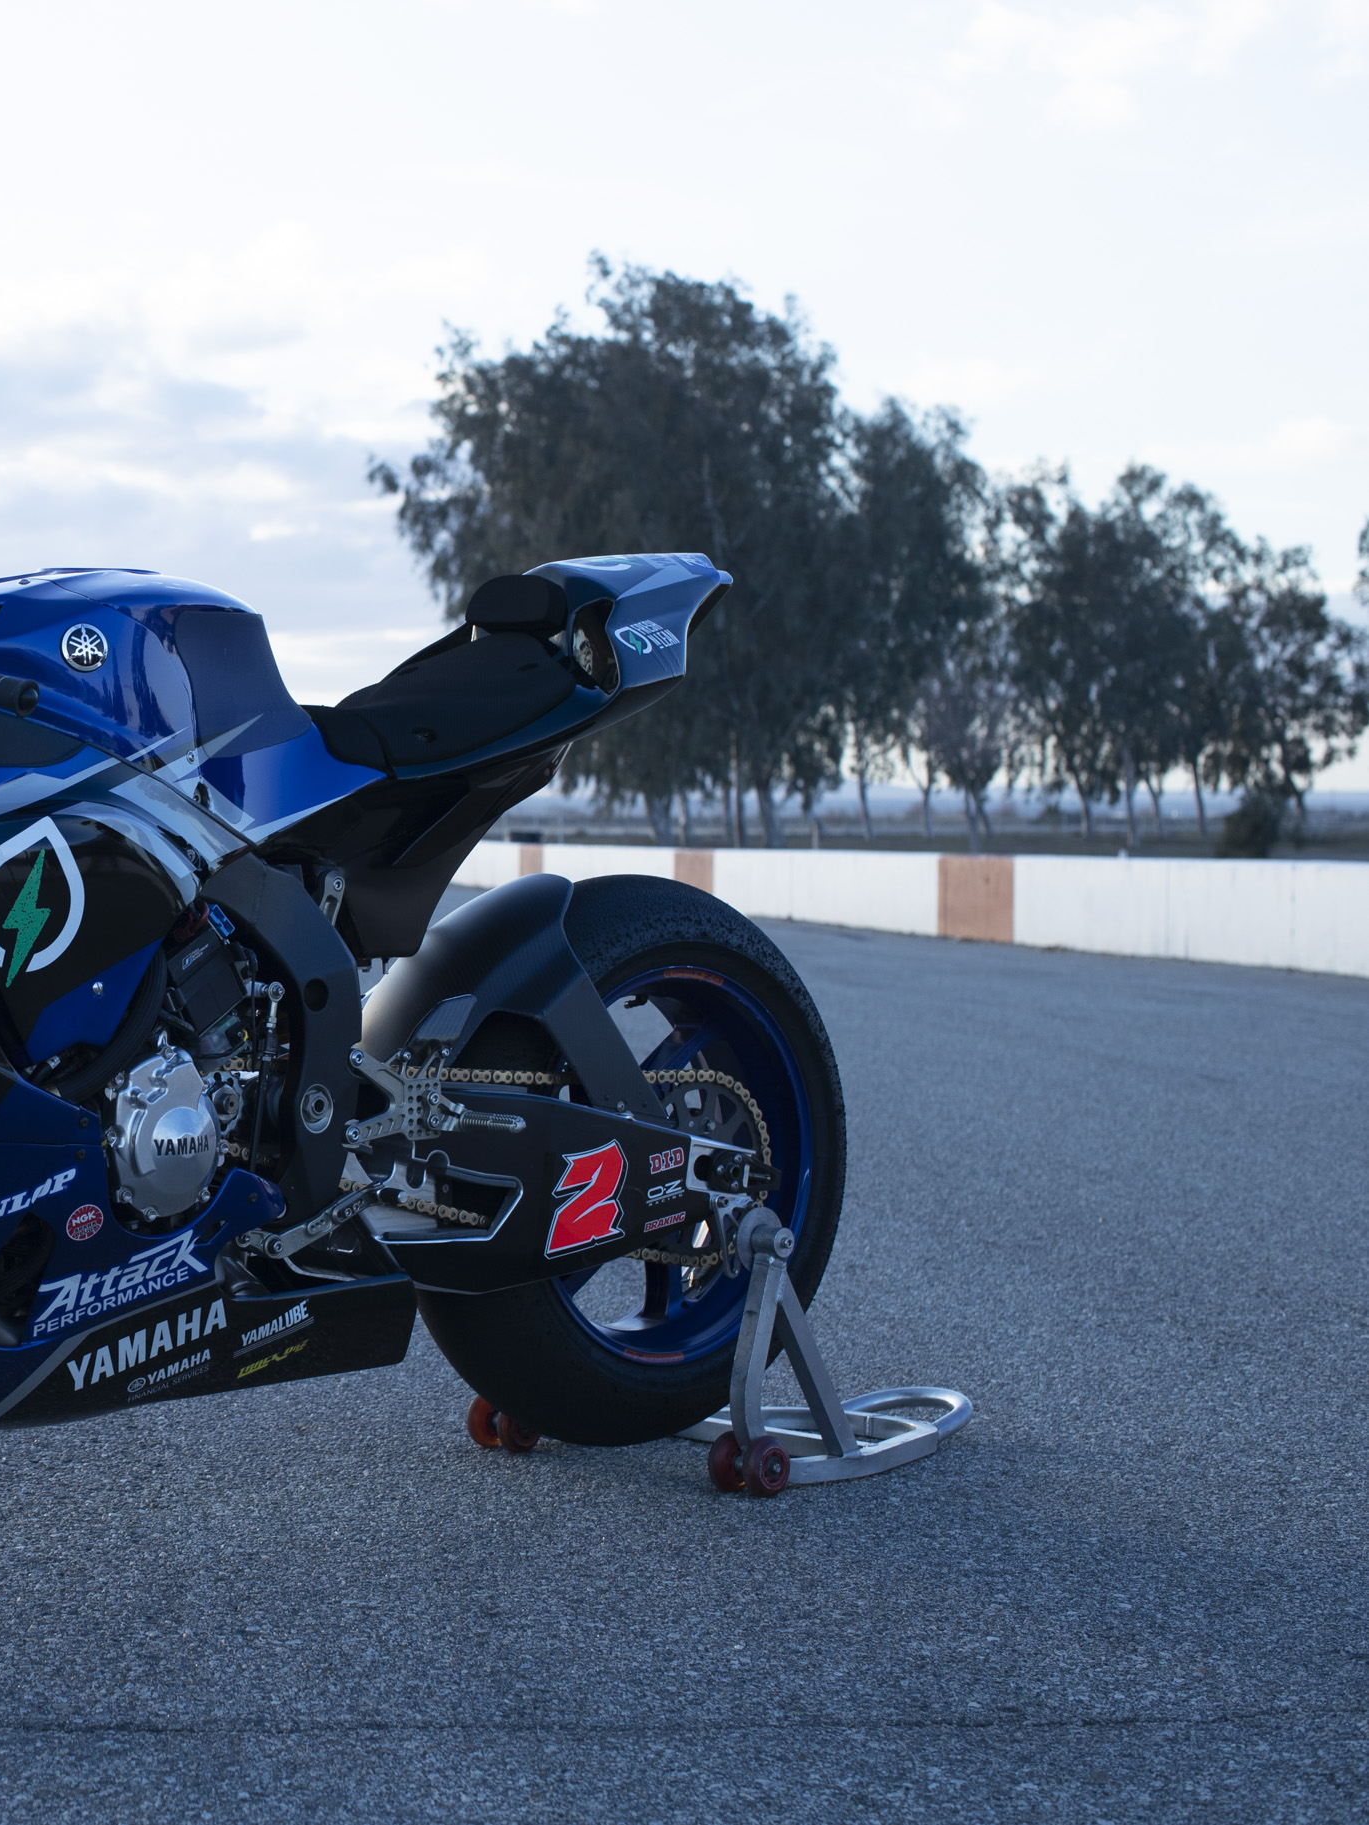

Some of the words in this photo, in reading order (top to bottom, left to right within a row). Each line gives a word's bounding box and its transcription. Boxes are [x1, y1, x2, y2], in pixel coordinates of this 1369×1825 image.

[153, 1133, 210, 1158] YAMAHA
[546, 1140, 627, 1257] 2
[71, 1210, 96, 1227] NGK
[644, 1211, 686, 1233] BRAKING
[33, 1268, 190, 1337] PERFORMANCE
[240, 1300, 310, 1348] YAMALUBE
[67, 1299, 228, 1392] YAMAHA
[127, 1382, 171, 1403] FINANCIAL
[171, 1364, 211, 1386] SERVICES
[147, 1348, 211, 1386] YAMAHA
